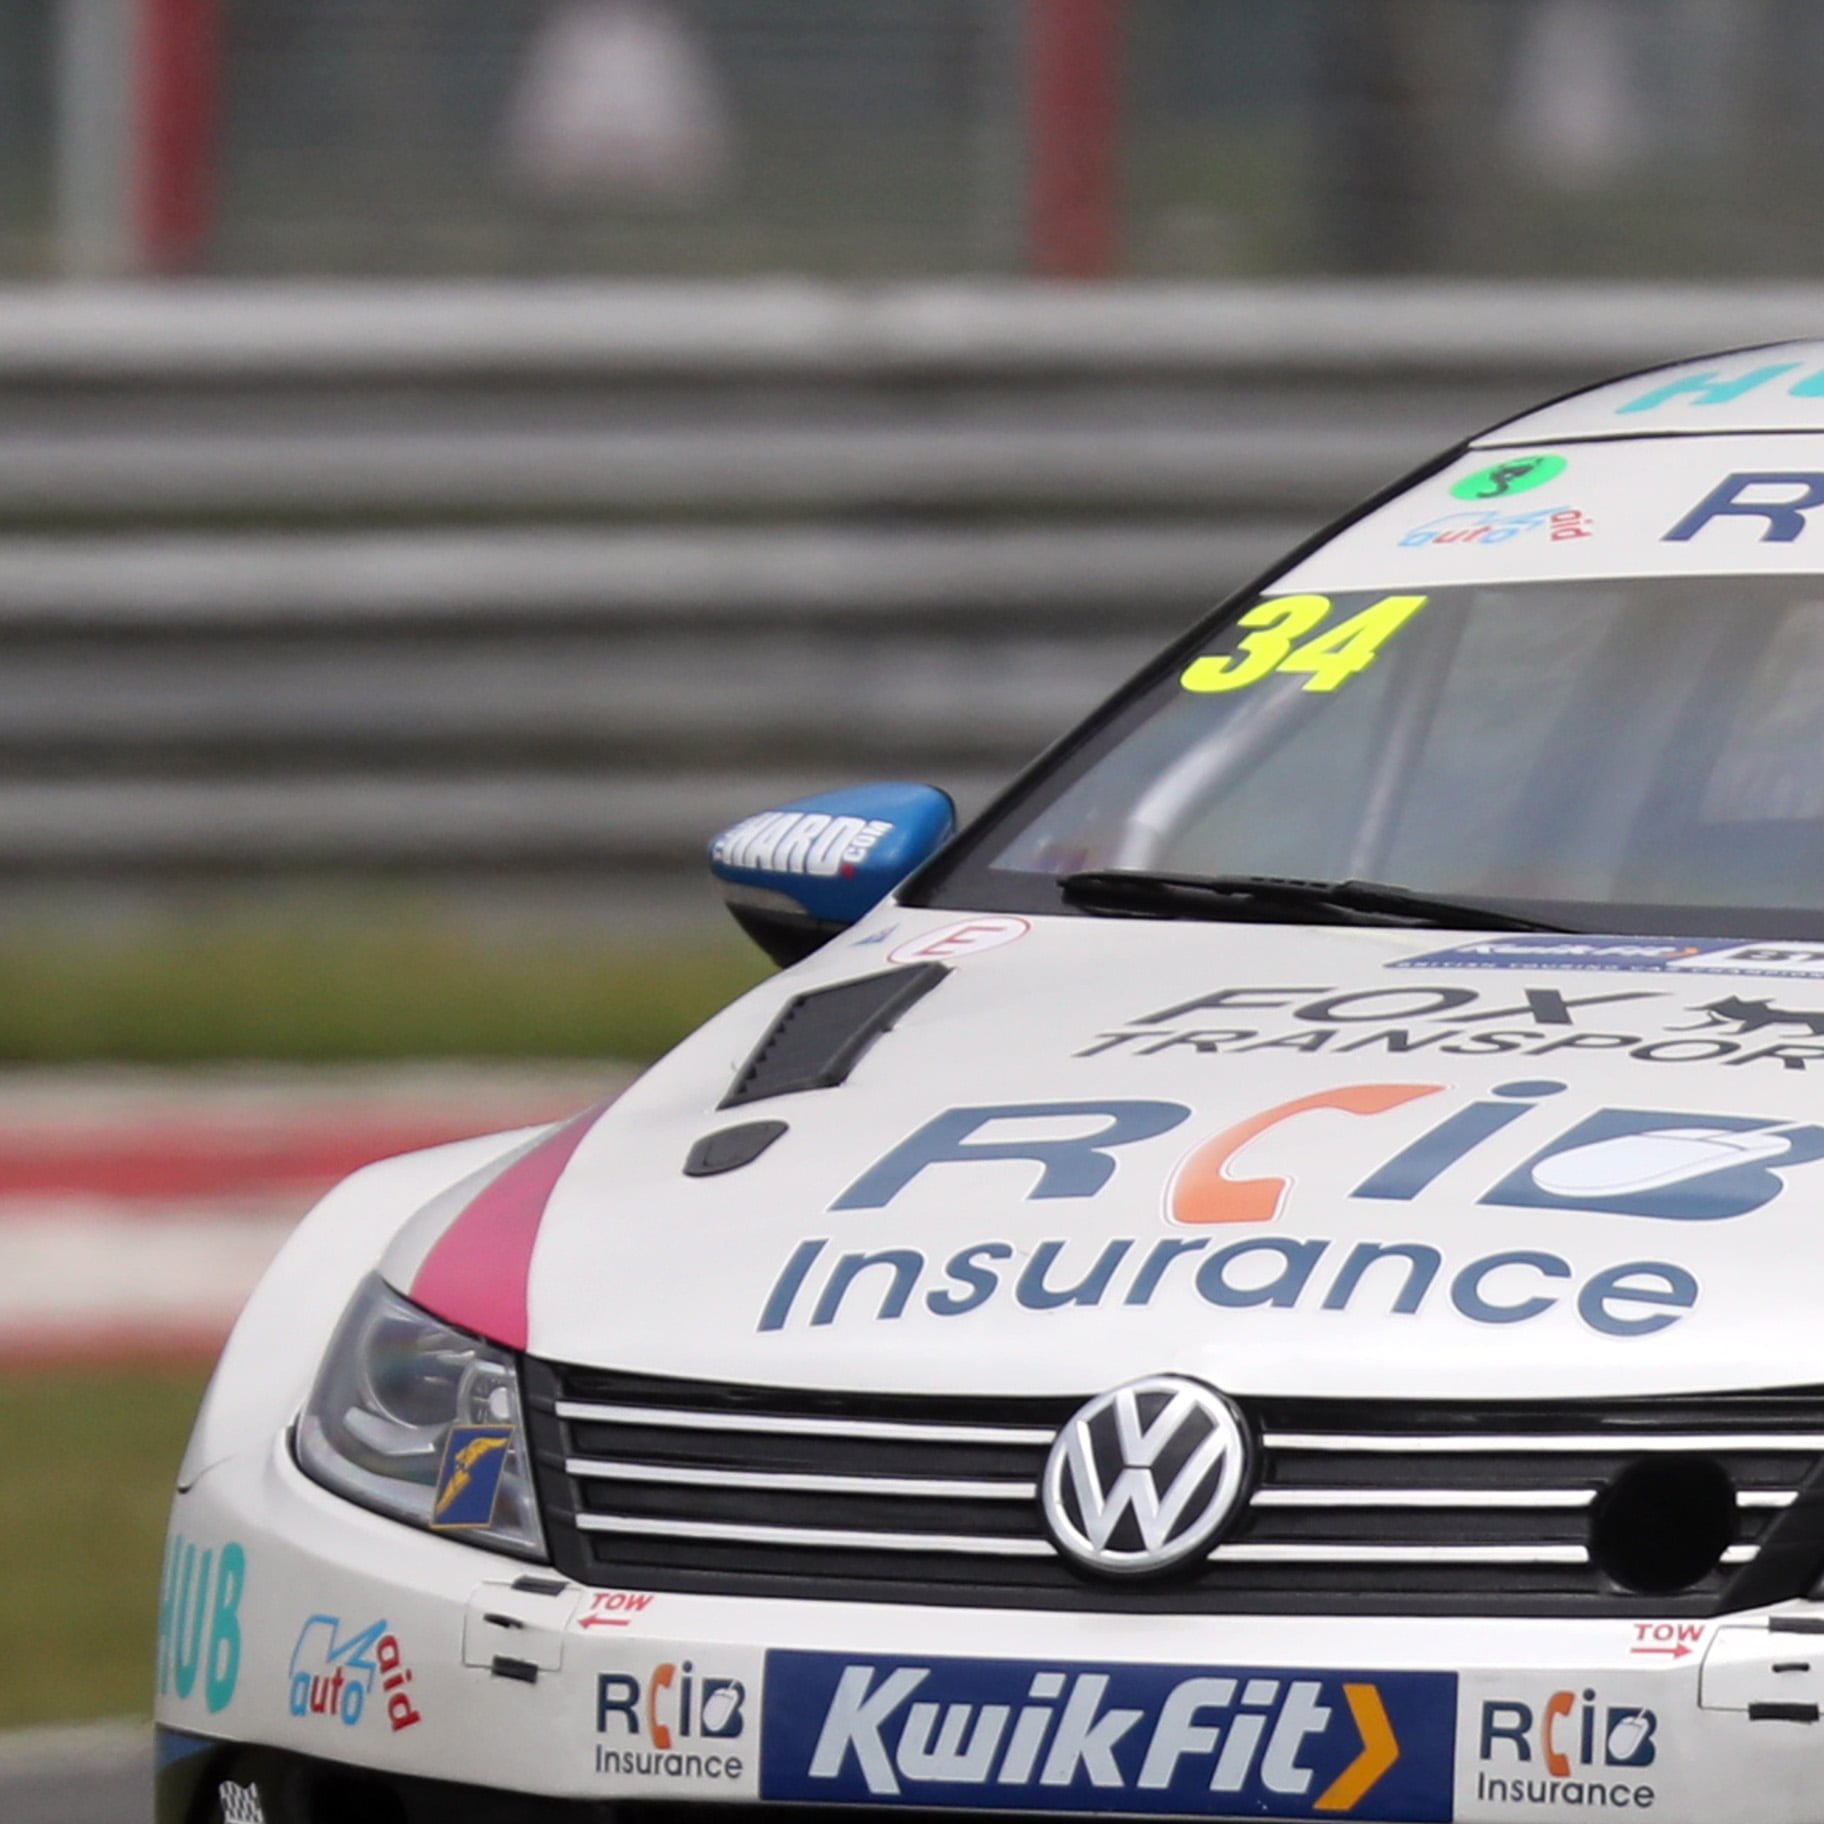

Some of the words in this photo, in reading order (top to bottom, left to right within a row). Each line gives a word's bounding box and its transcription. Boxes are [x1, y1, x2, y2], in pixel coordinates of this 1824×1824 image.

[1181, 595, 1428, 693] 34
[722, 811, 867, 876] HARD
[1125, 986, 1673, 1027] FOX
[757, 1236, 1701, 1337] Insurance
[160, 1534, 245, 1714] HUB
[591, 1593, 653, 1612] TOW
[1634, 1623, 1705, 1643] TOW
[289, 1669, 366, 1726] auto
[375, 1635, 421, 1733] aid
[595, 1744, 743, 1779] Insurance
[1477, 1772, 1655, 1808] Insurance
